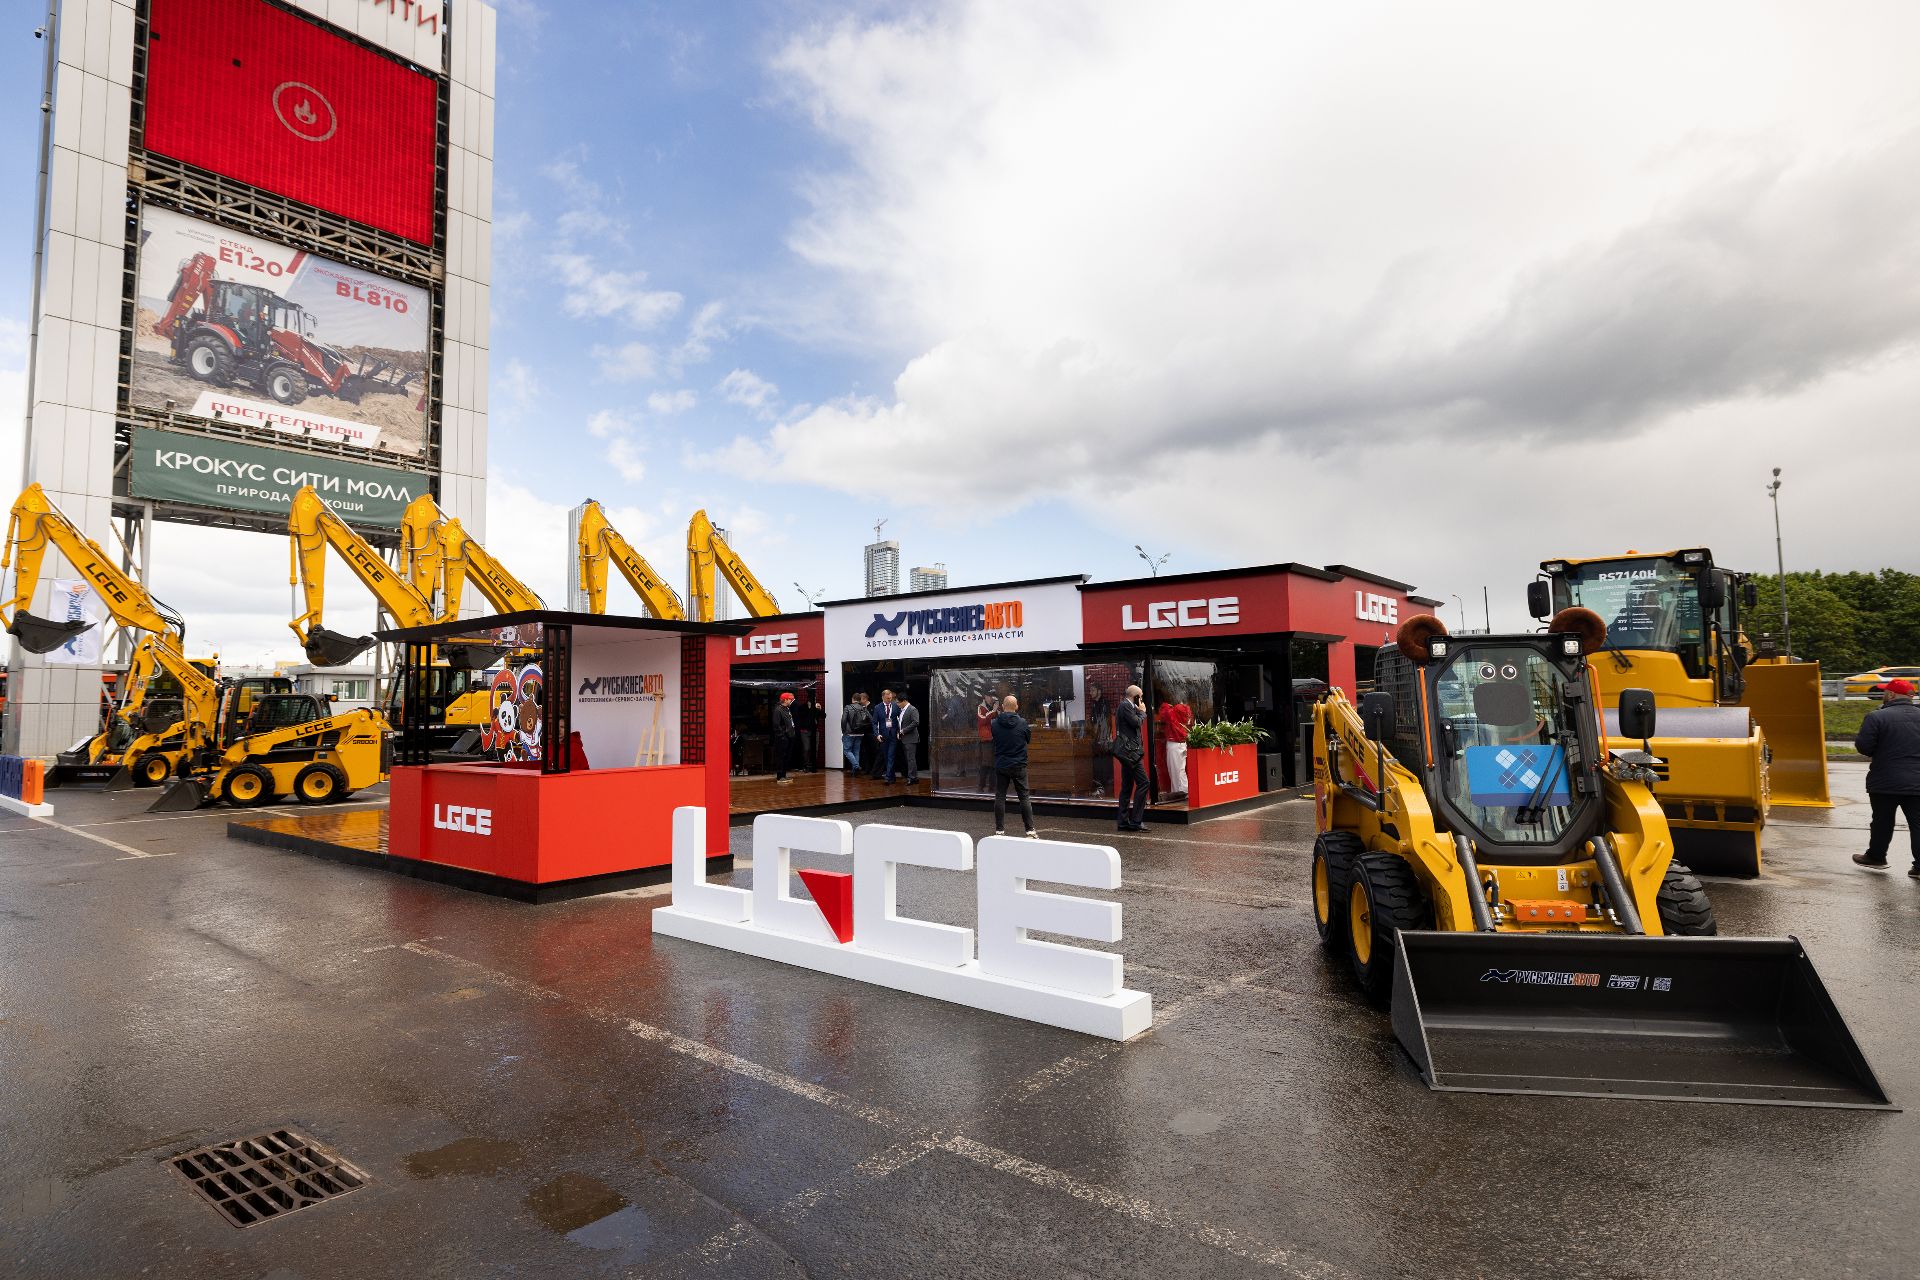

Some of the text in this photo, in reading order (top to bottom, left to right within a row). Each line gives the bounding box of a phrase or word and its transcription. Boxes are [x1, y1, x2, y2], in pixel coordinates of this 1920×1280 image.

[219, 246, 283, 277] E1.20
[336, 281, 408, 314] BL810
[155, 449, 412, 503] КРОКУС СИТИ МОЛЛ
[216, 484, 364, 512] ПРИРОДА КОШИ
[346, 544, 385, 583] LGCE
[624, 556, 654, 591] LGCE
[728, 560, 753, 593] LGCE
[1598, 569, 1657, 582] RS7140H
[85, 562, 129, 604] LGCE
[487, 570, 513, 597] LGCE
[907, 600, 1023, 636] РУСБИЗНЕСАВТО
[1122, 596, 1240, 631] LGCE
[1355, 590, 1398, 625] LGCE
[735, 633, 799, 656] LGCE
[866, 630, 1024, 648] АВТОТЕХНИКА СЕРВИС ЗАПЧАСТИ
[602, 673, 664, 695] РУСБИЗНЕСАВТО
[296, 720, 334, 736] LGCE
[1214, 770, 1239, 786] LGCE
[434, 803, 492, 836] LGCE
[671, 805, 1124, 998] LGCE
[1515, 969, 1600, 987] РУСБИЗНЕСАВТО
